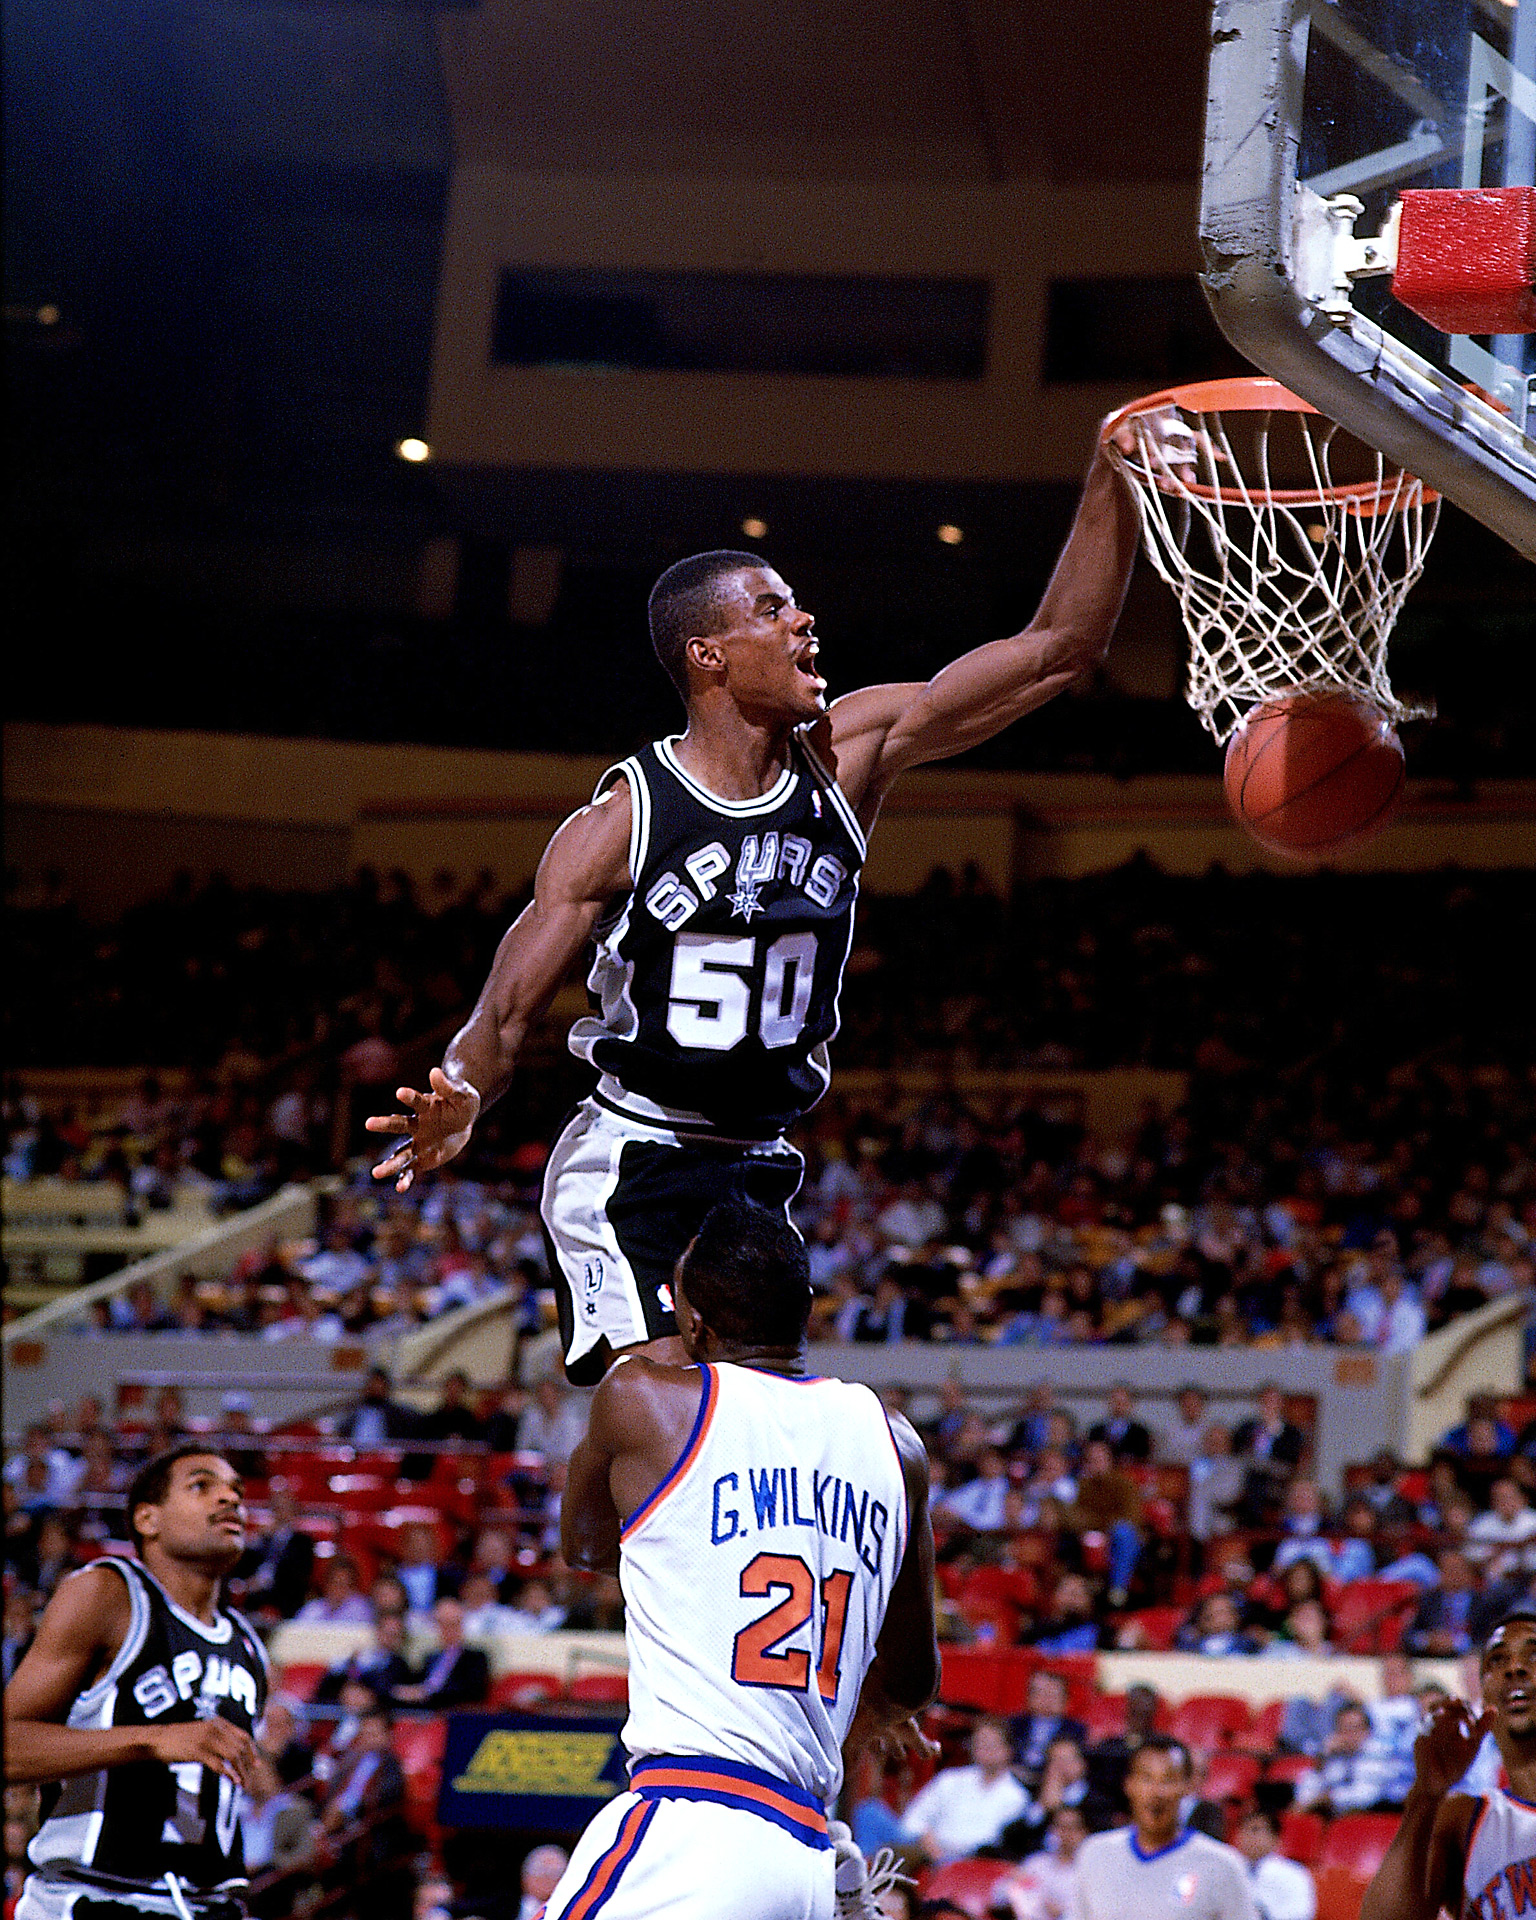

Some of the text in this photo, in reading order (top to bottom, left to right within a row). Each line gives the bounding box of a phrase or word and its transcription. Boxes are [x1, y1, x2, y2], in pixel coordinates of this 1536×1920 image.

[645, 831, 848, 932] SPURS
[666, 931, 819, 1051] 50
[731, 1551, 855, 1706] 21
